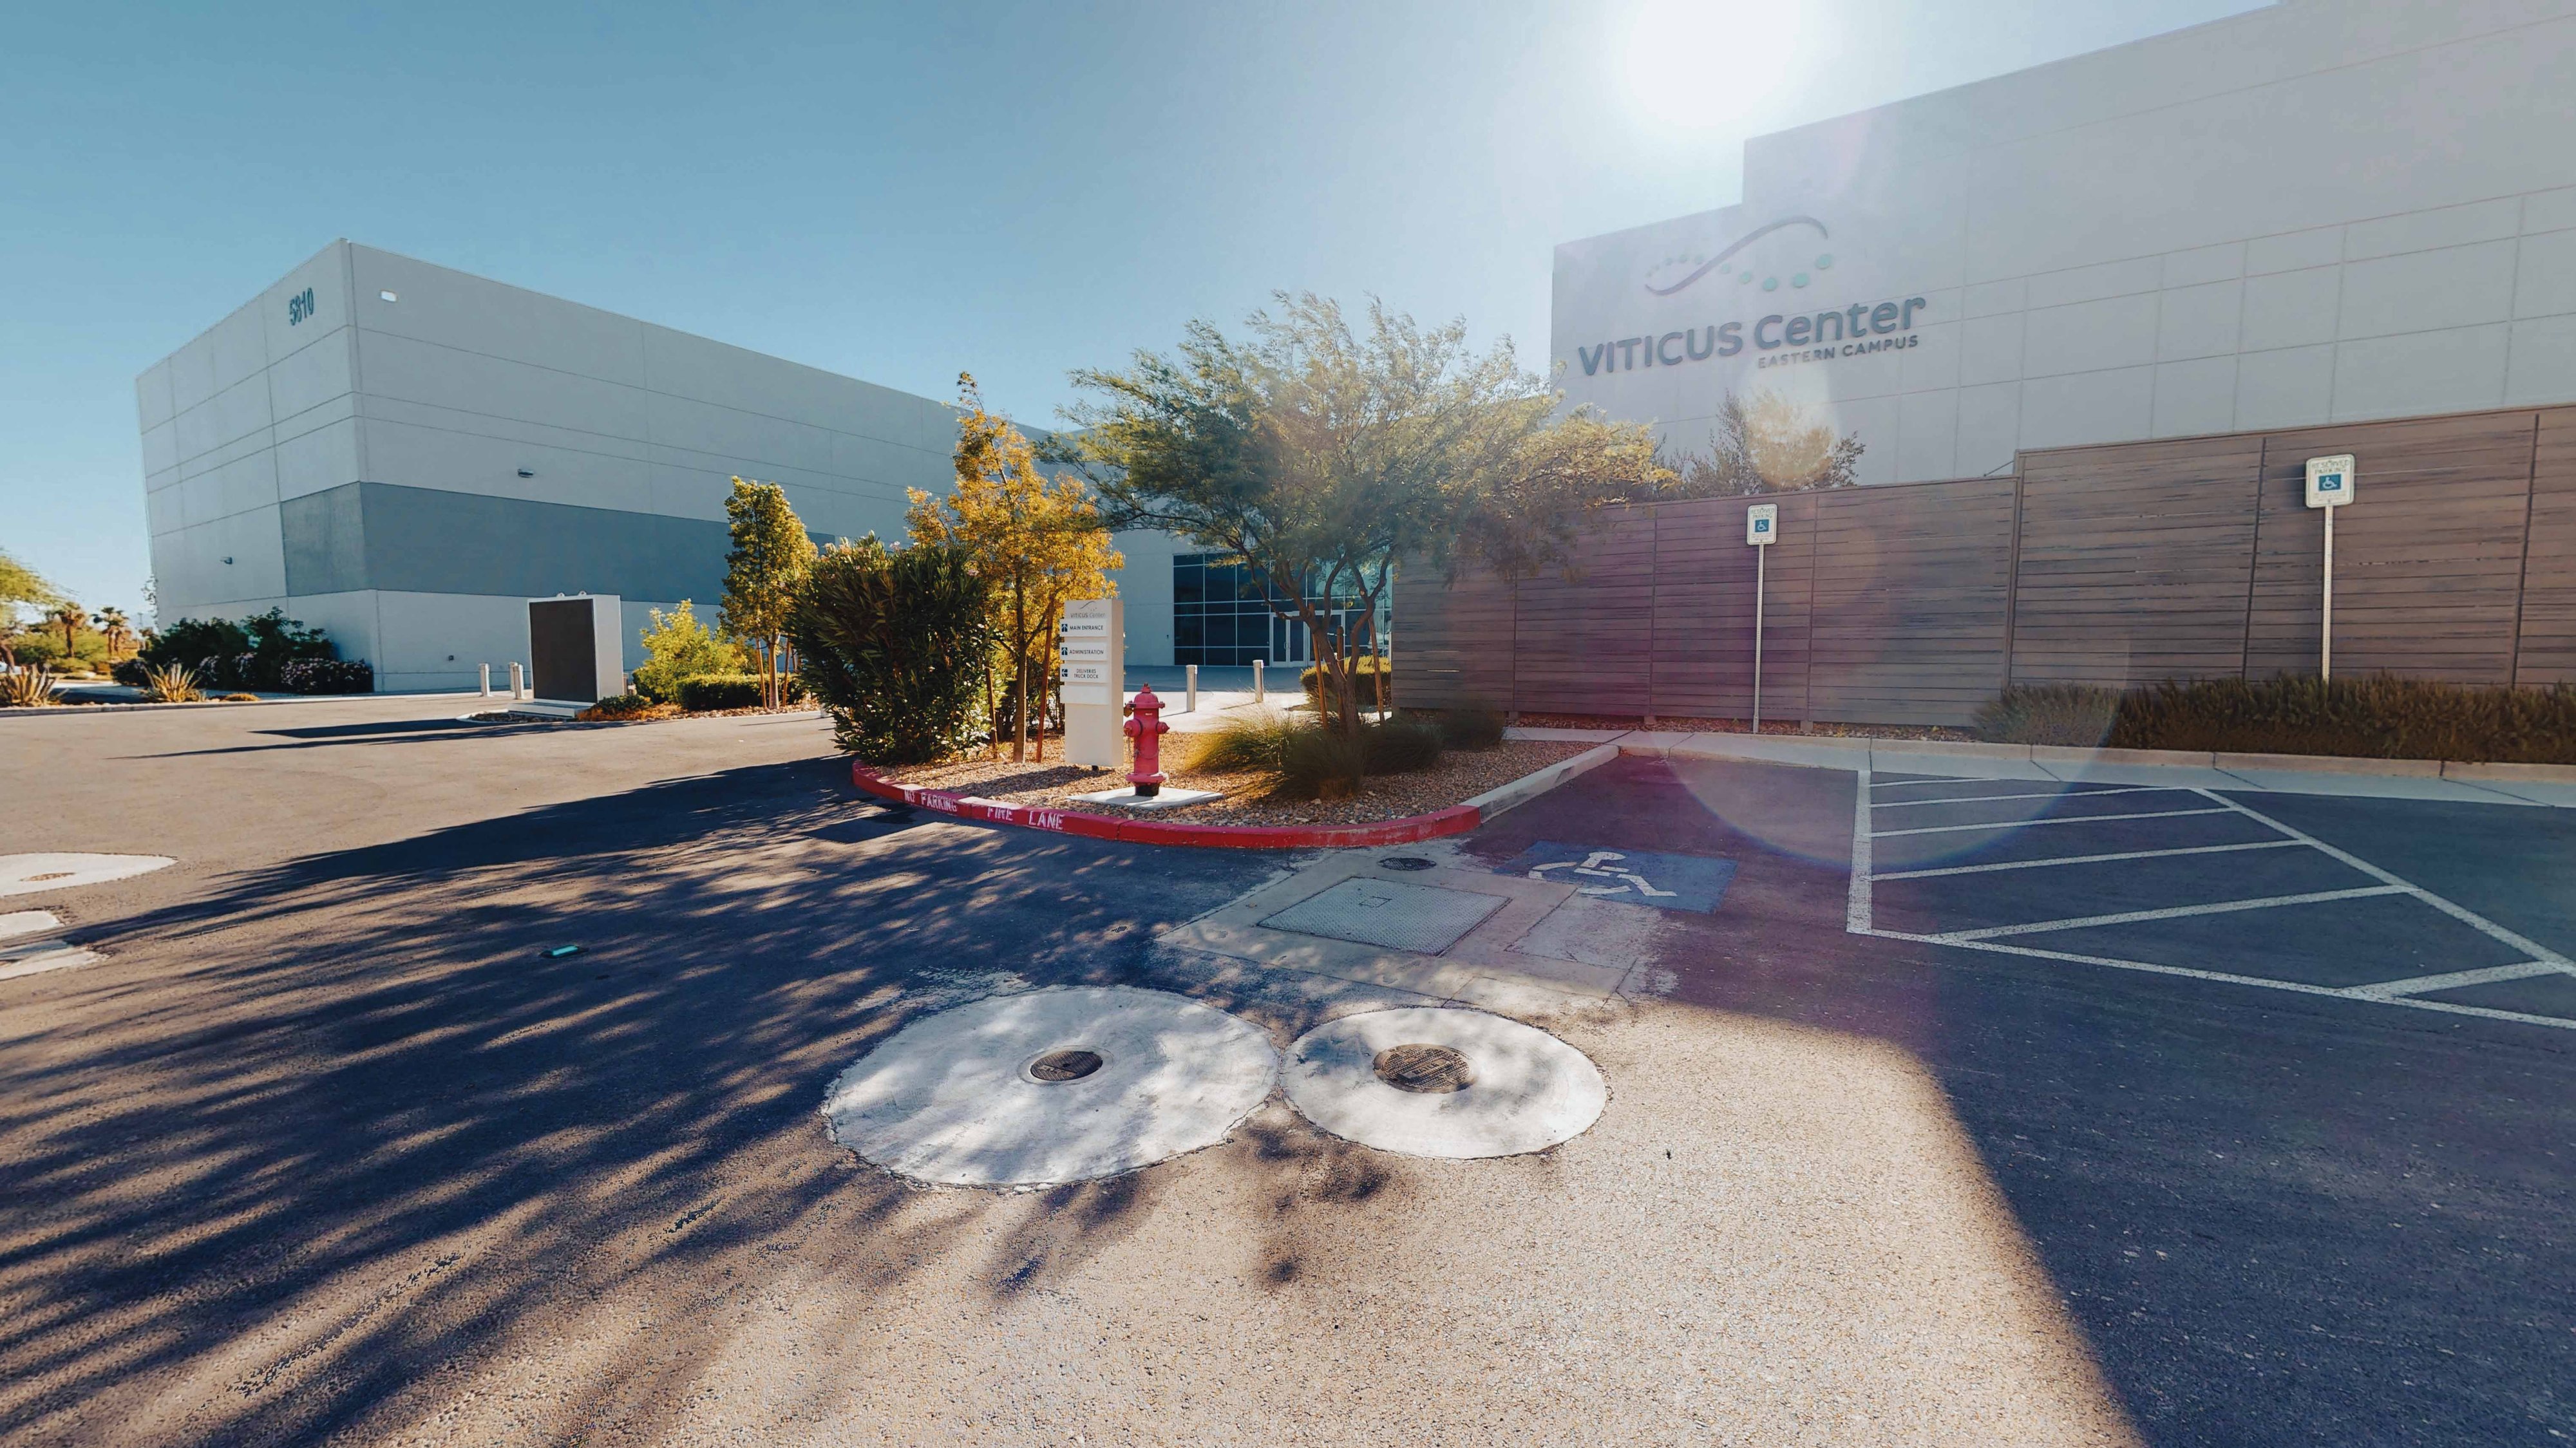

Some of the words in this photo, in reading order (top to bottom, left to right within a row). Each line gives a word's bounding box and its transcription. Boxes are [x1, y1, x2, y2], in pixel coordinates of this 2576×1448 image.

[289, 287, 314, 326] 5810
[1578, 321, 1743, 375] VITICUS
[1754, 297, 1926, 349] Center
[1758, 347, 1835, 368] EASTERN
[1842, 335, 1918, 357] CAMPUS
[904, 789, 915, 803] NO
[921, 792, 958, 813] PARKING
[987, 805, 1014, 822] FIRE
[1028, 810, 1065, 830] LANE
